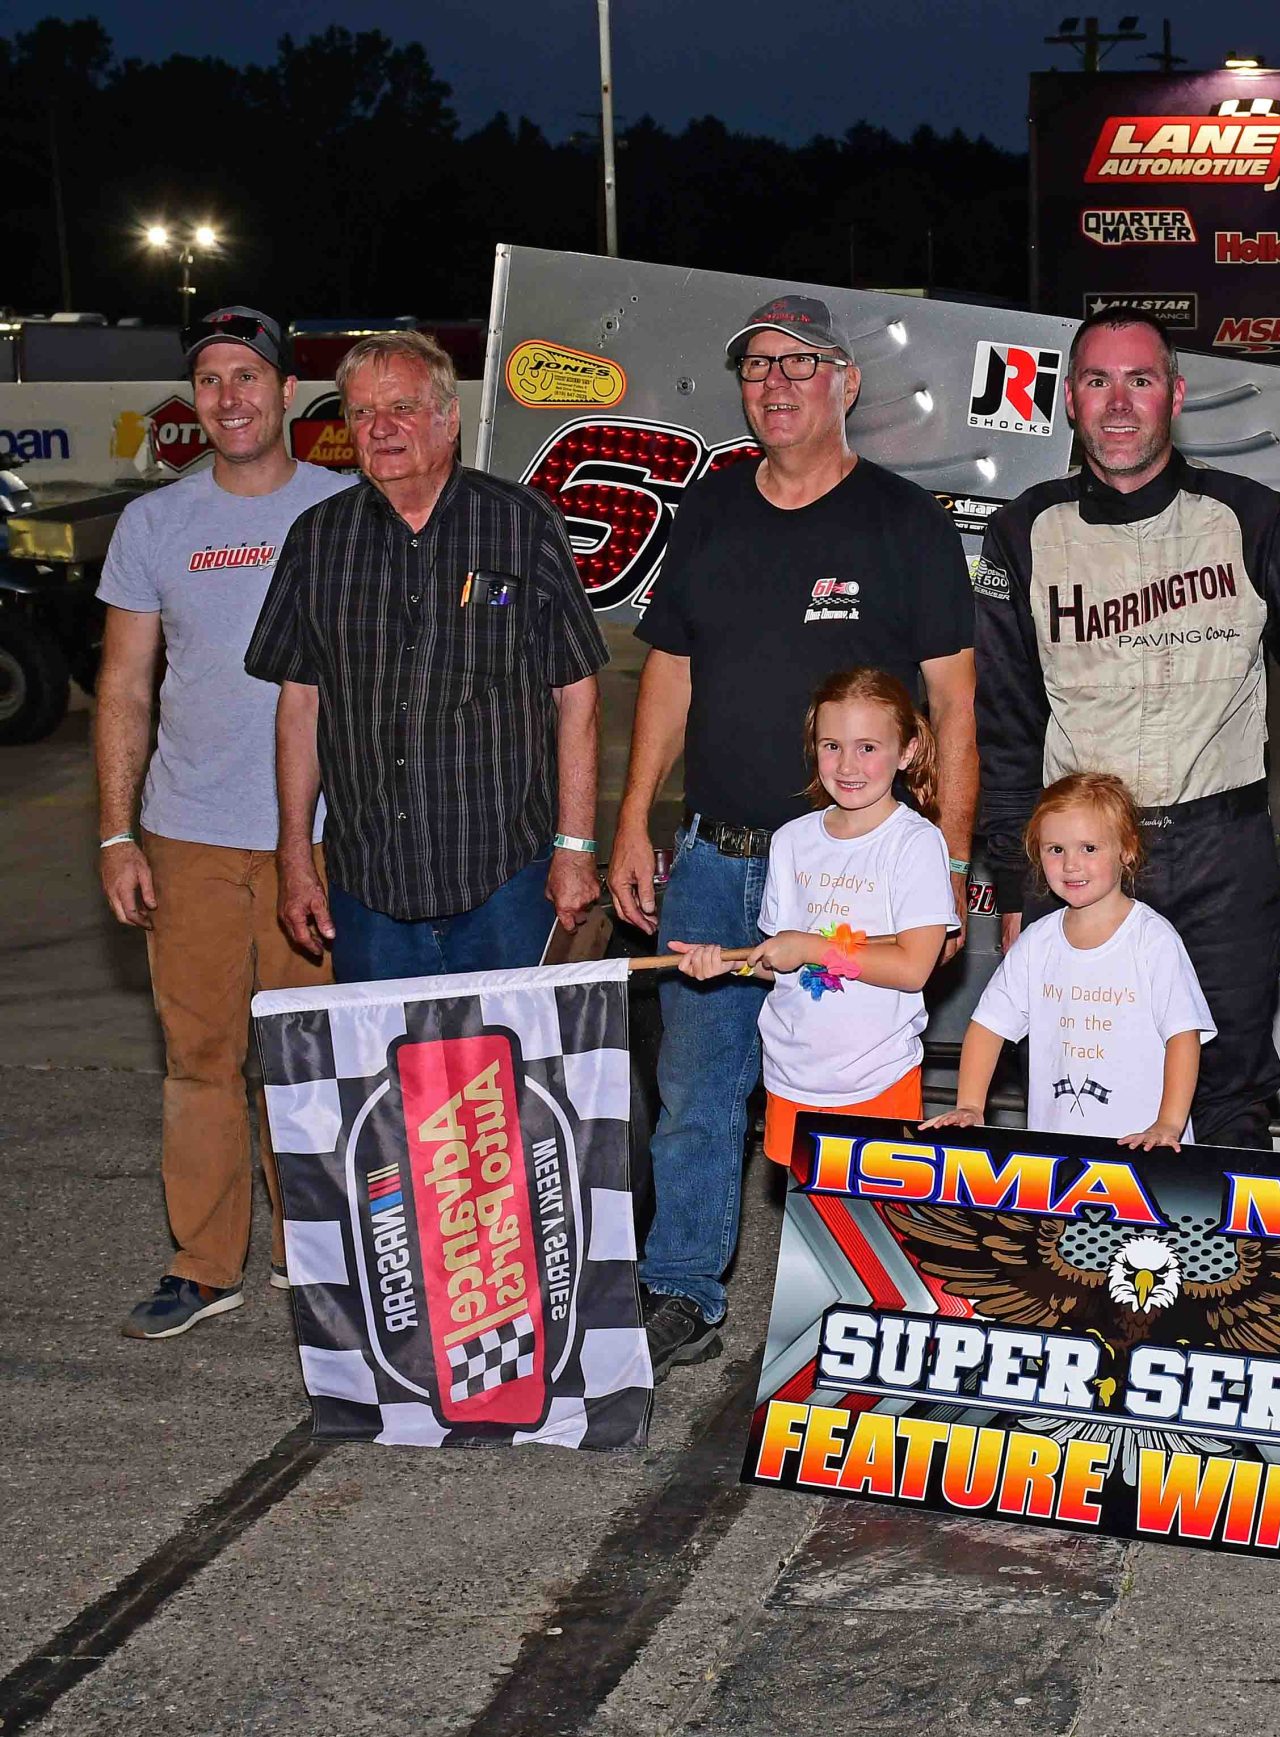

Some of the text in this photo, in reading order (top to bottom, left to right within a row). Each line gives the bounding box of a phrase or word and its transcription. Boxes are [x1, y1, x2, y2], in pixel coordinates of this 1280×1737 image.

[1098, 158, 1270, 176] AUTOMOTIVE
[1083, 211, 1186, 236] QUARTER
[1102, 225, 1191, 243] MASTER
[529, 360, 611, 377] JONES
[970, 417, 1050, 434] SHOCKS
[516, 414, 762, 613] 6
[188, 545, 276, 573] ORDWAY
[812, 578, 837, 598] 61
[983, 575, 1008, 587] 500
[1048, 562, 1238, 643] HARRINGTON
[1118, 630, 1202, 648] PAVING
[820, 872, 875, 894] Daddy's
[807, 899, 850, 917] on the
[1042, 983, 1136, 1006] My Daddy's
[1059, 1014, 1112, 1031] on the
[1062, 1041, 1104, 1059] Track
[809, 1131, 1168, 1228] ISMA
[820, 1307, 1104, 1414] SUPER
[755, 1400, 1107, 1526] FEATURE
